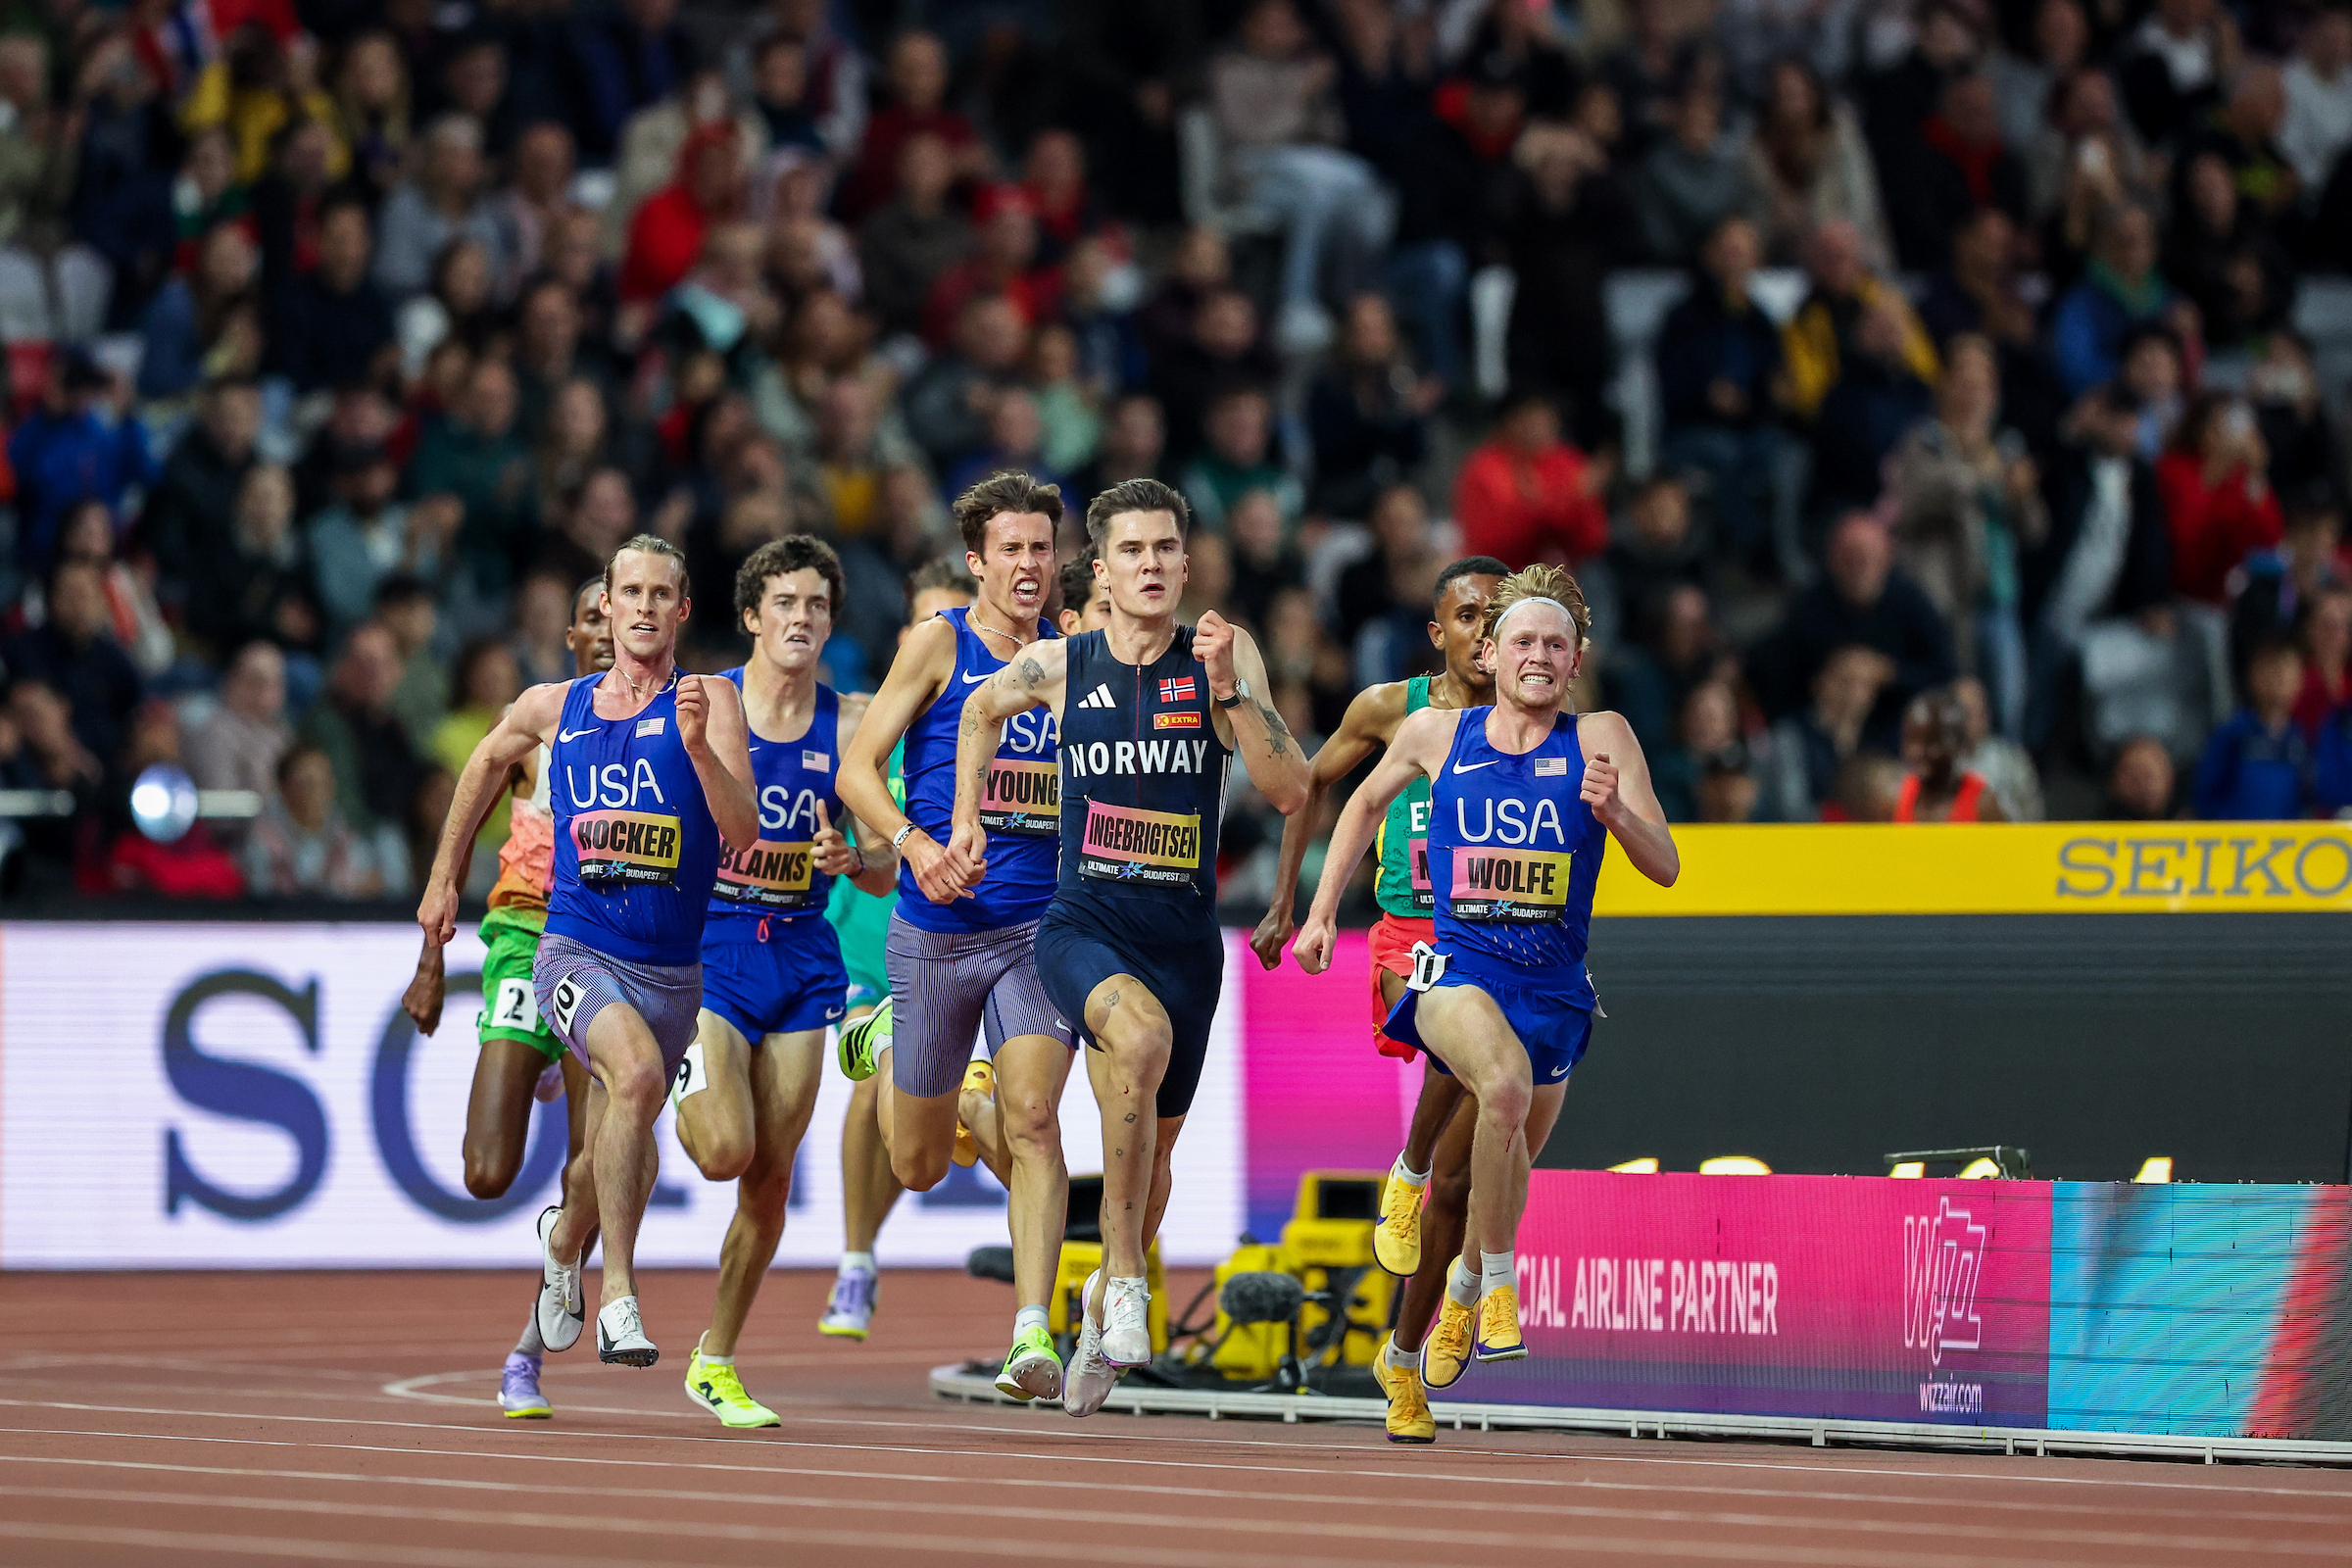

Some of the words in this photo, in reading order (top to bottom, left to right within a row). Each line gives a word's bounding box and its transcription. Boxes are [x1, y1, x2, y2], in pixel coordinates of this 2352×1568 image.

[1068, 739, 1208, 778] NORWAY
[566, 758, 664, 808] USA
[987, 769, 1058, 807] YOUNG
[756, 785, 816, 834] SA
[979, 815, 1004, 826] TIMATE
[1456, 797, 1565, 845] USA
[577, 819, 676, 859] HOCKER
[1088, 812, 1198, 859] INGEBRIGTSEN
[580, 864, 604, 874] ULTIMATE
[718, 840, 808, 882] BLANKS
[1088, 860, 1119, 874] ULTIMATE
[1468, 858, 1556, 896] WOLFE
[2056, 835, 2352, 899] SEIKO
[713, 882, 740, 896] TIMATE
[1456, 904, 1489, 914] ULTIMATE
[503, 987, 525, 1021] 2
[677, 1057, 692, 1093] 9
[1515, 1254, 1566, 1327] CIAL
[1571, 1256, 1665, 1330] AIRLINE
[1670, 1259, 1779, 1336] PARTNER
[1919, 1372, 1983, 1413] wizzair.com
